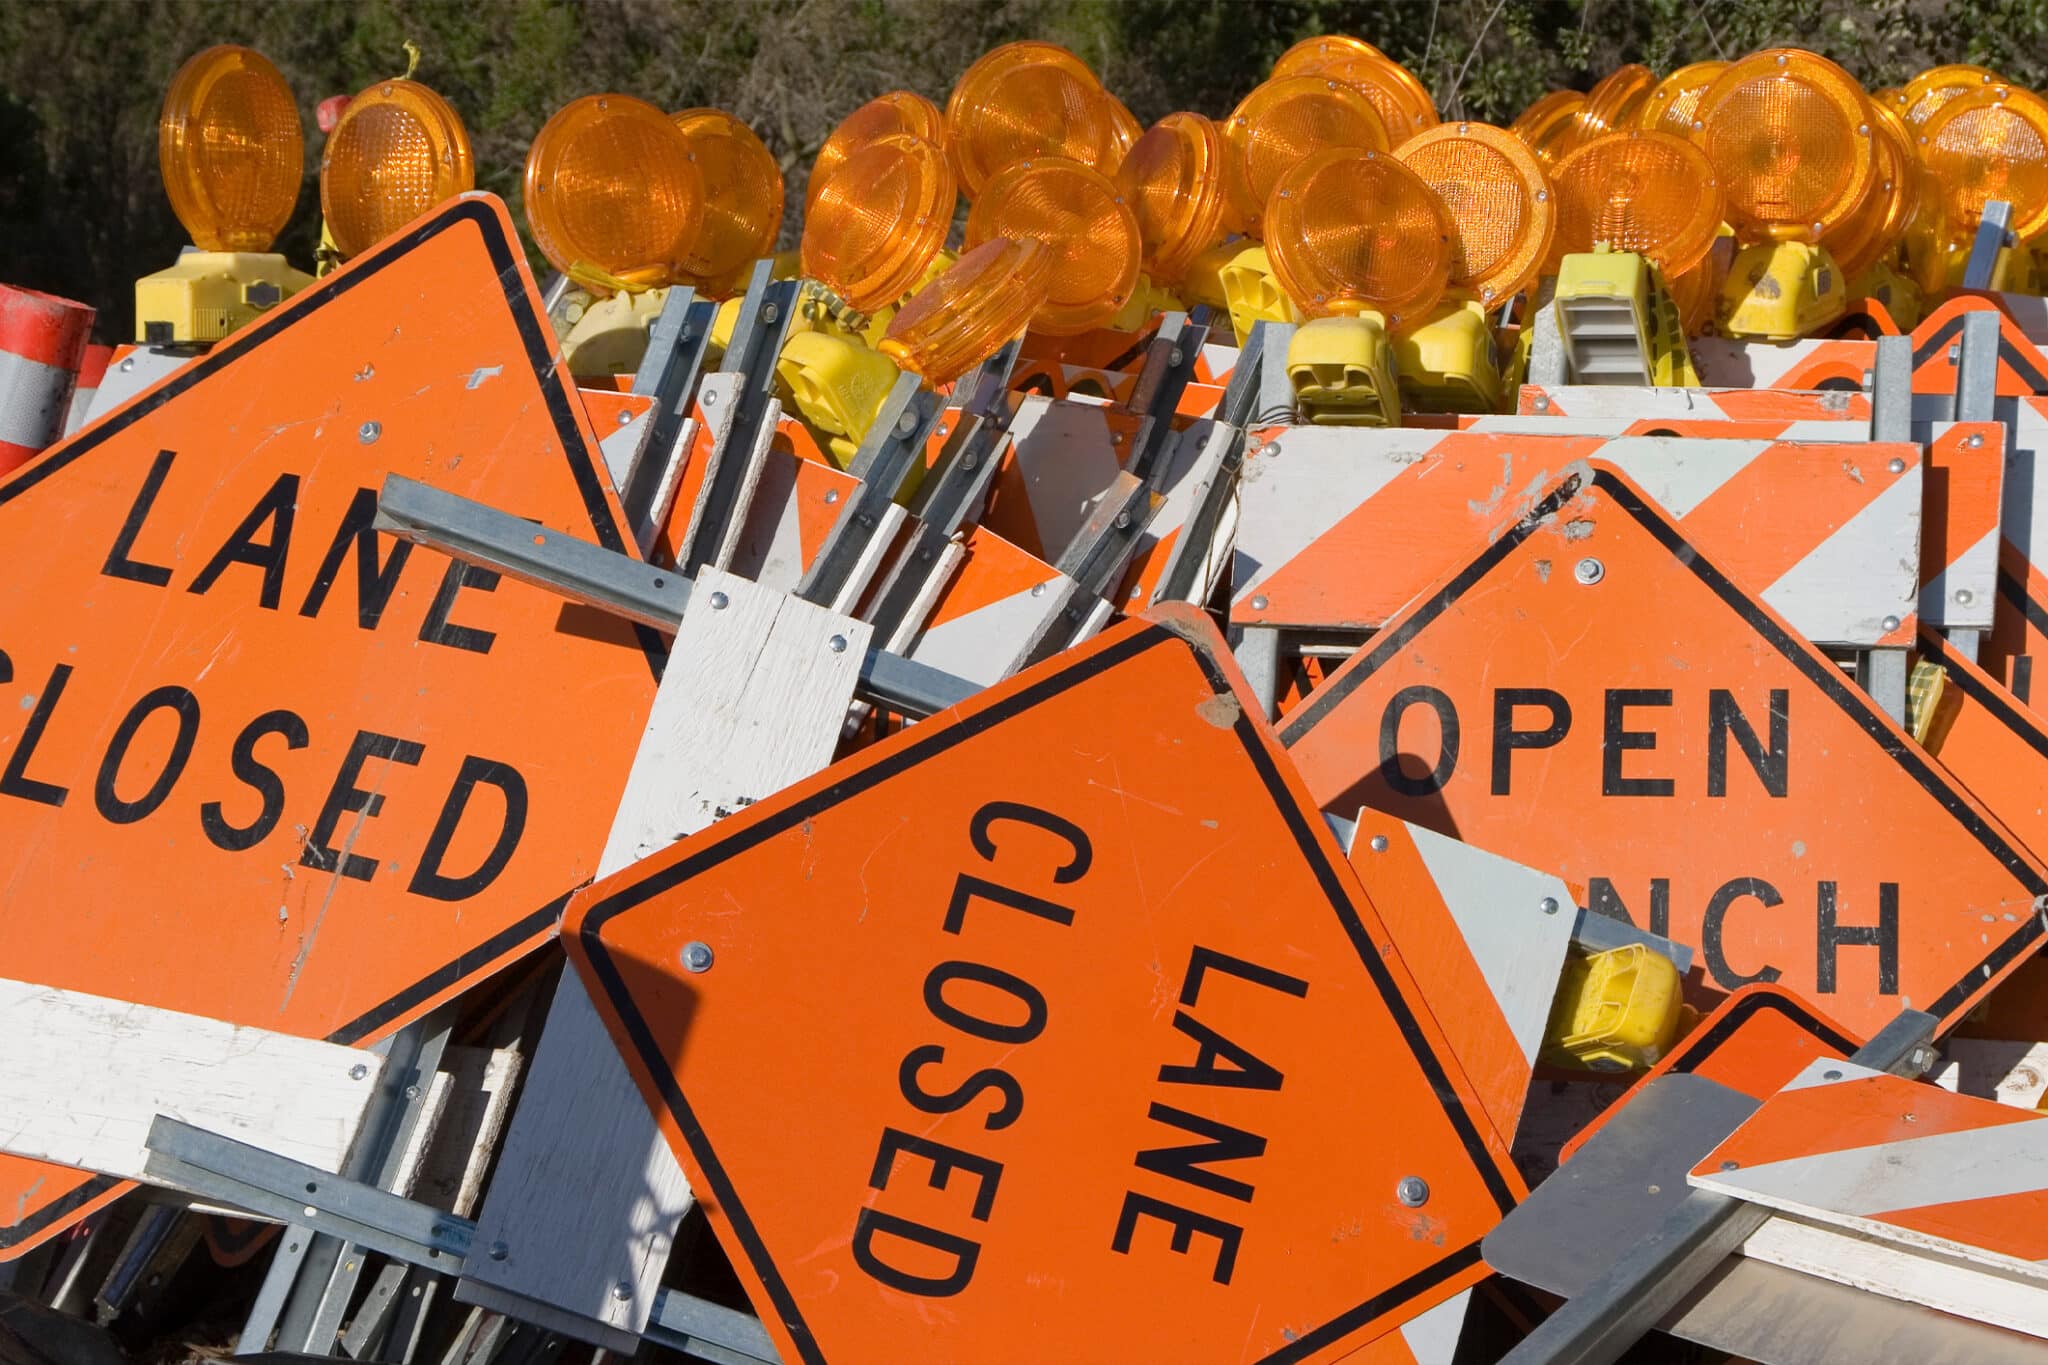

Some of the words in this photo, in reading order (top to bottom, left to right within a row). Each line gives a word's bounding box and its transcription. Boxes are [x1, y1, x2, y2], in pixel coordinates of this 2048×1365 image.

[101, 449, 543, 654] LANE
[0, 647, 529, 901] LOSED
[1379, 685, 1790, 798] OPEN
[851, 800, 1093, 1298] CLOSED
[1110, 944, 1309, 1286] LANE
